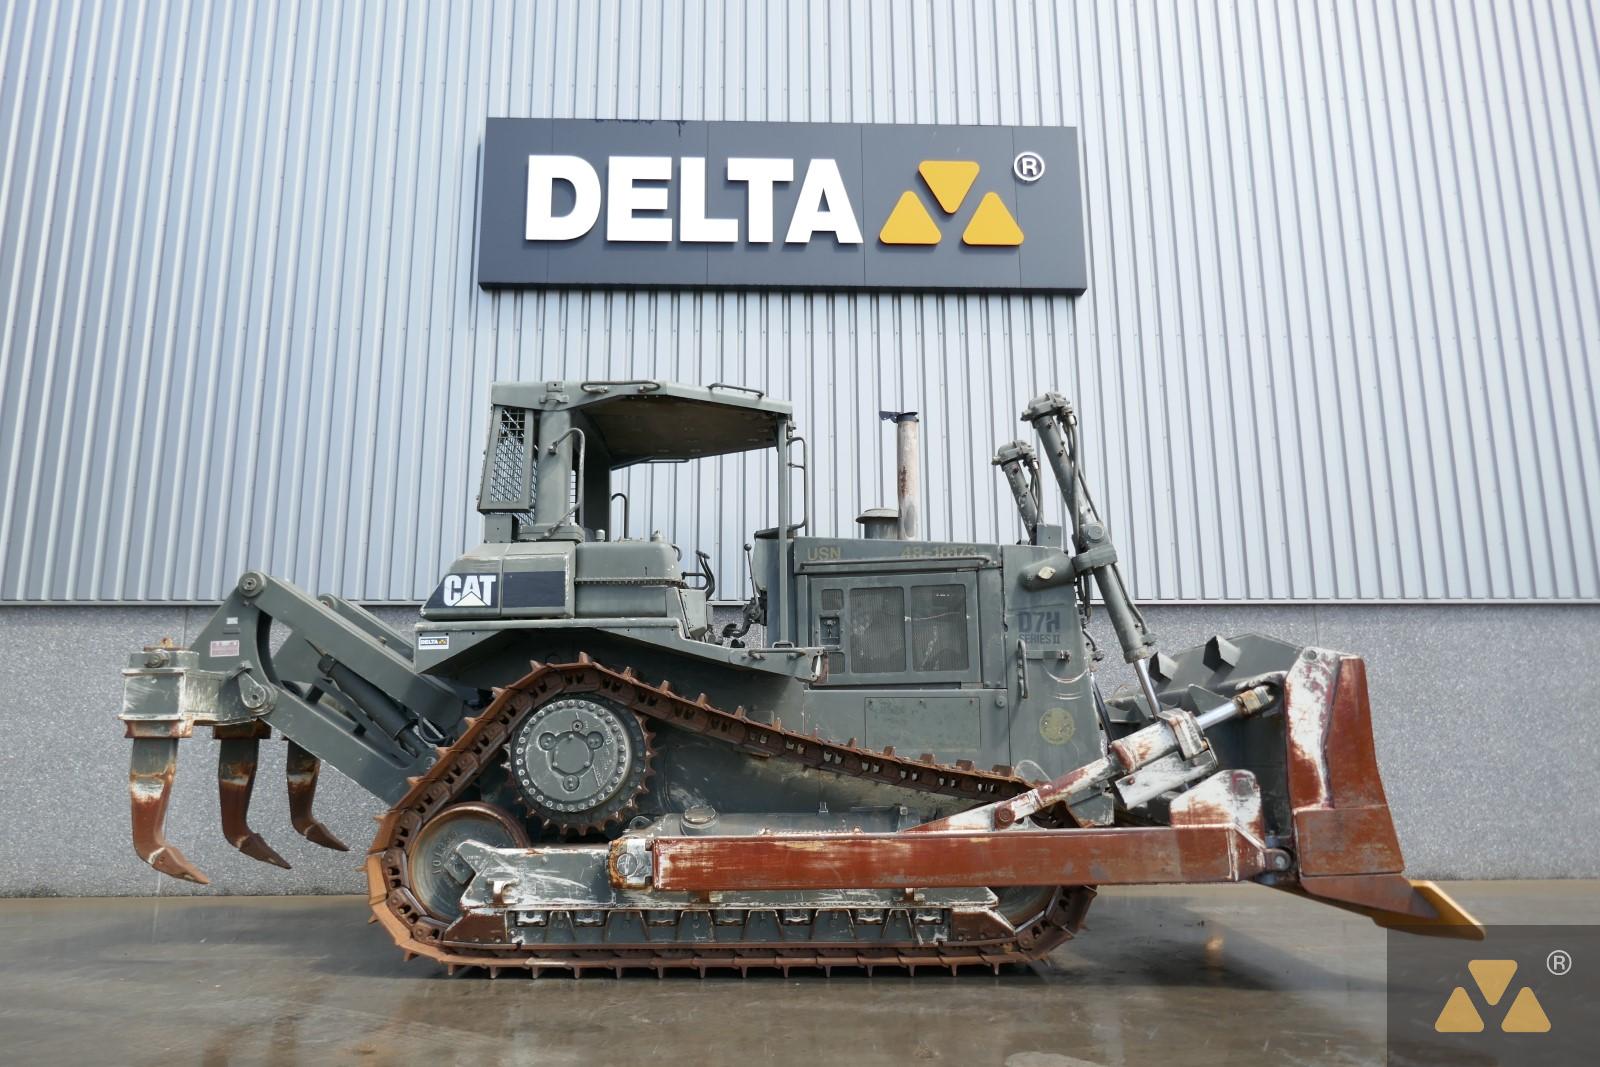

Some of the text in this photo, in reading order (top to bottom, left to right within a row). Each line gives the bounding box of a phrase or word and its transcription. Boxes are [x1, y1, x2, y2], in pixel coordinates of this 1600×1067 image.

[525, 154, 864, 245] DELTA
[807, 546, 841, 561] USN
[443, 574, 497, 607] CAT
[1018, 611, 1061, 633] D7H
[1019, 634, 1052, 645] SERIES
